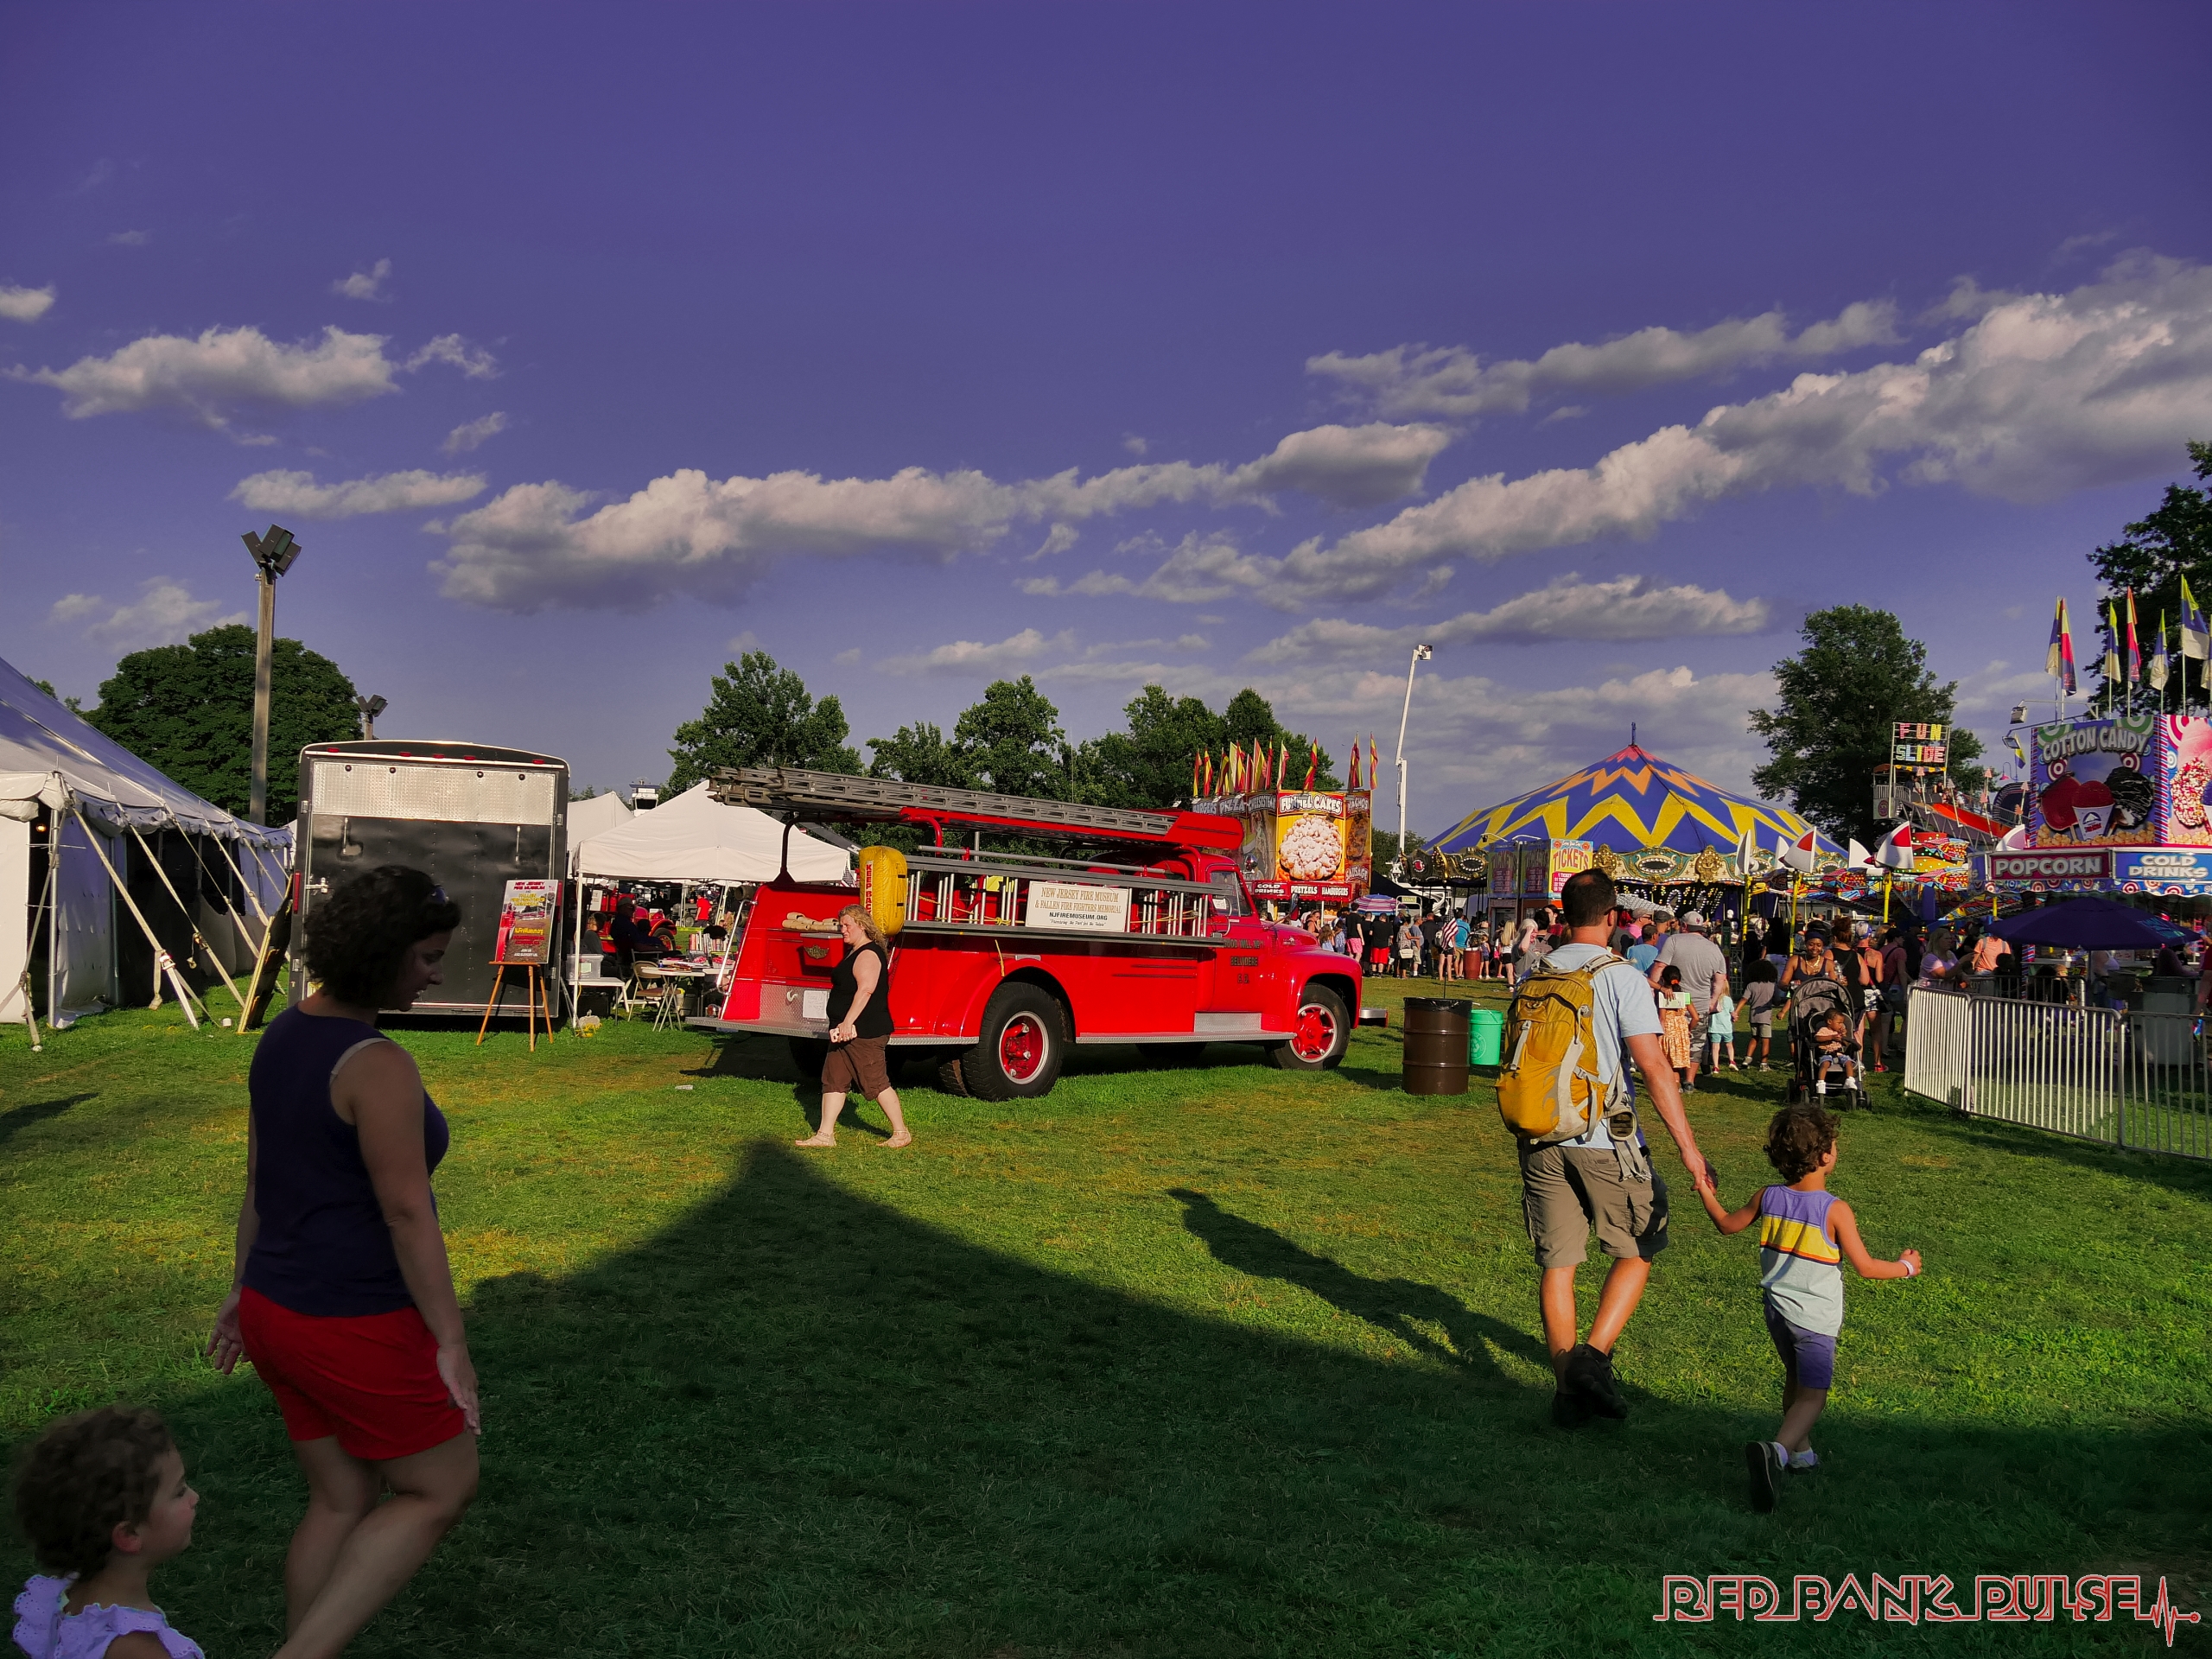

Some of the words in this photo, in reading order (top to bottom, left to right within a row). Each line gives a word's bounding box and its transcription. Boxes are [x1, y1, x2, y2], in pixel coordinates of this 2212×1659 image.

[1899, 722, 1942, 741] FUN
[2044, 726, 2096, 762] COTTON
[2100, 726, 2148, 755] CANDY
[1896, 745, 1946, 763] SLIDE
[1219, 798, 1245, 815] PIZZA
[1280, 794, 1313, 811] FUNNEL
[1313, 794, 1343, 814] CAKES
[1553, 848, 1589, 872] TICKETS
[1994, 855, 2103, 878] POPCORN
[2139, 854, 2198, 868] COLD
[1345, 866, 1369, 881] SAUSAGE
[2128, 865, 2209, 879] DRINKS
[1041, 887, 1056, 898] NEW
[1057, 888, 1080, 900] JERSEY
[1081, 890, 1094, 901] FIRE
[1095, 891, 1119, 903] MUSEUM
[1290, 885, 1318, 895] PRETZELS
[1035, 900, 1040, 909] &
[1040, 900, 1061, 910] FALLEN
[1061, 901, 1072, 911] FIRE
[1073, 902, 1097, 912] FIGHTERS
[1097, 904, 1122, 914] MEMORIAL
[1049, 912, 1107, 921] NJFIREMUSEUM.ORG
[1239, 939, 1252, 949] WILL
[1230, 956, 1259, 966] BELVIDERE
